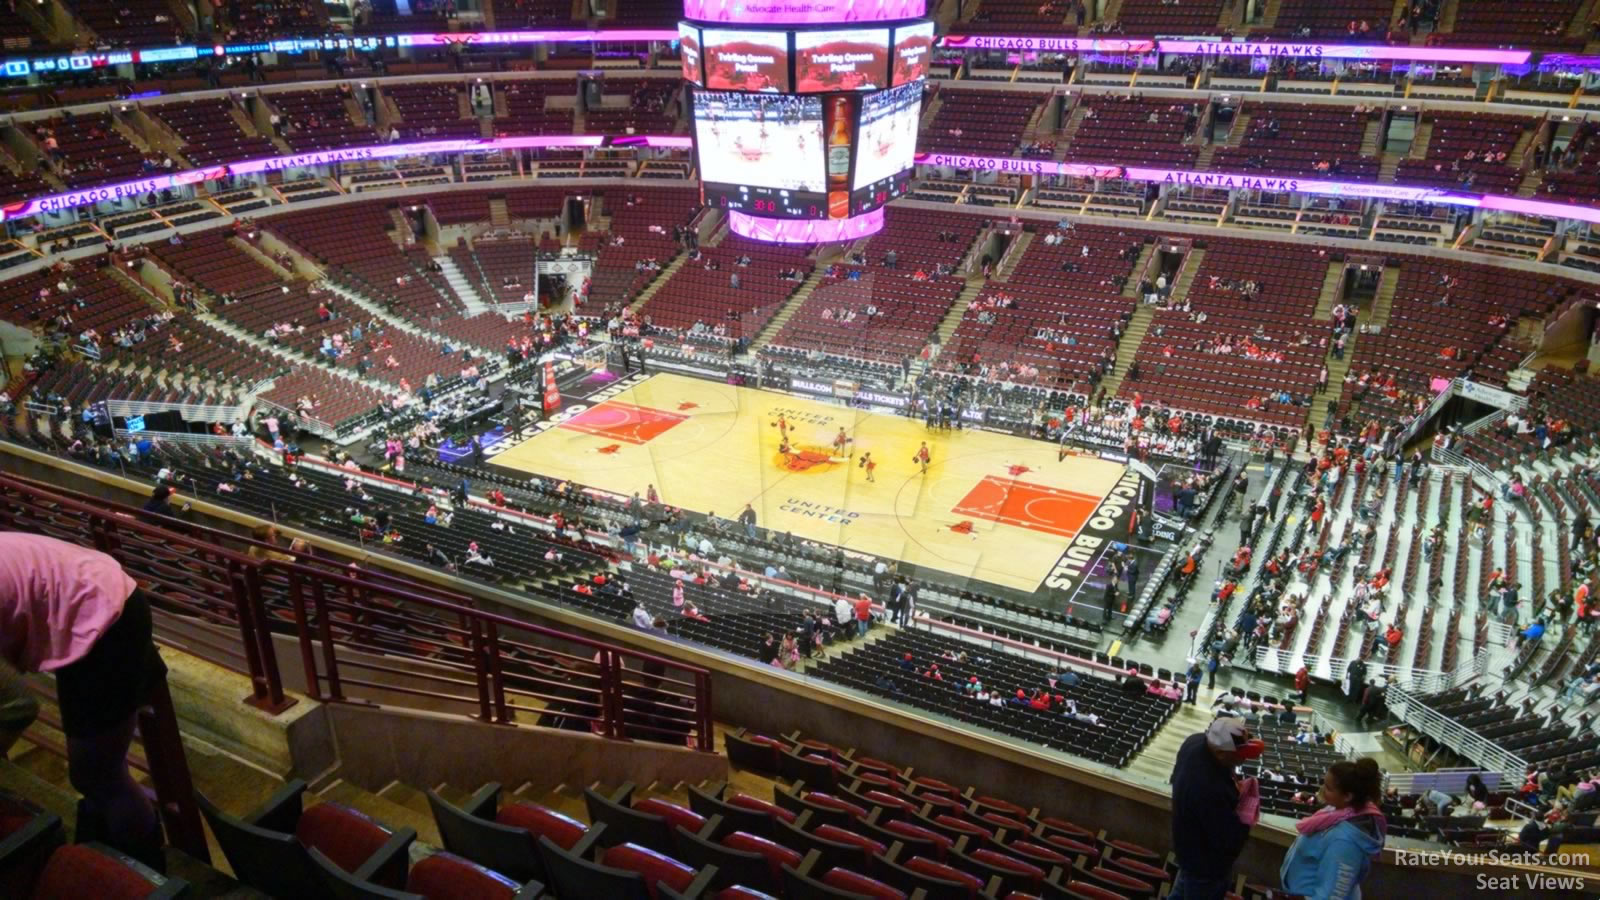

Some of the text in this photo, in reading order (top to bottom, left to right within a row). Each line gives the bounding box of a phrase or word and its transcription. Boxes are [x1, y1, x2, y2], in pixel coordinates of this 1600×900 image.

[745, 4, 835, 13] Advocate Health Care
[974, 37, 1079, 50] CHICAGO BULLS
[1195, 42, 1323, 57] ATLANTA HAWKS
[263, 148, 373, 171] ATLANTA HAWKS
[935, 155, 1043, 173] CHICAGO BULLS
[1164, 172, 1299, 192] ATLANTA HAWKS
[39, 180, 157, 212] CHICAGO BULLS
[586, 373, 650, 403] BULLS
[791, 380, 832, 394] BULLS.COM
[774, 407, 835, 420] UNITED
[779, 505, 852, 525] CENTER
[786, 498, 860, 518] UNITED
[1045, 534, 1104, 591] BULLS
